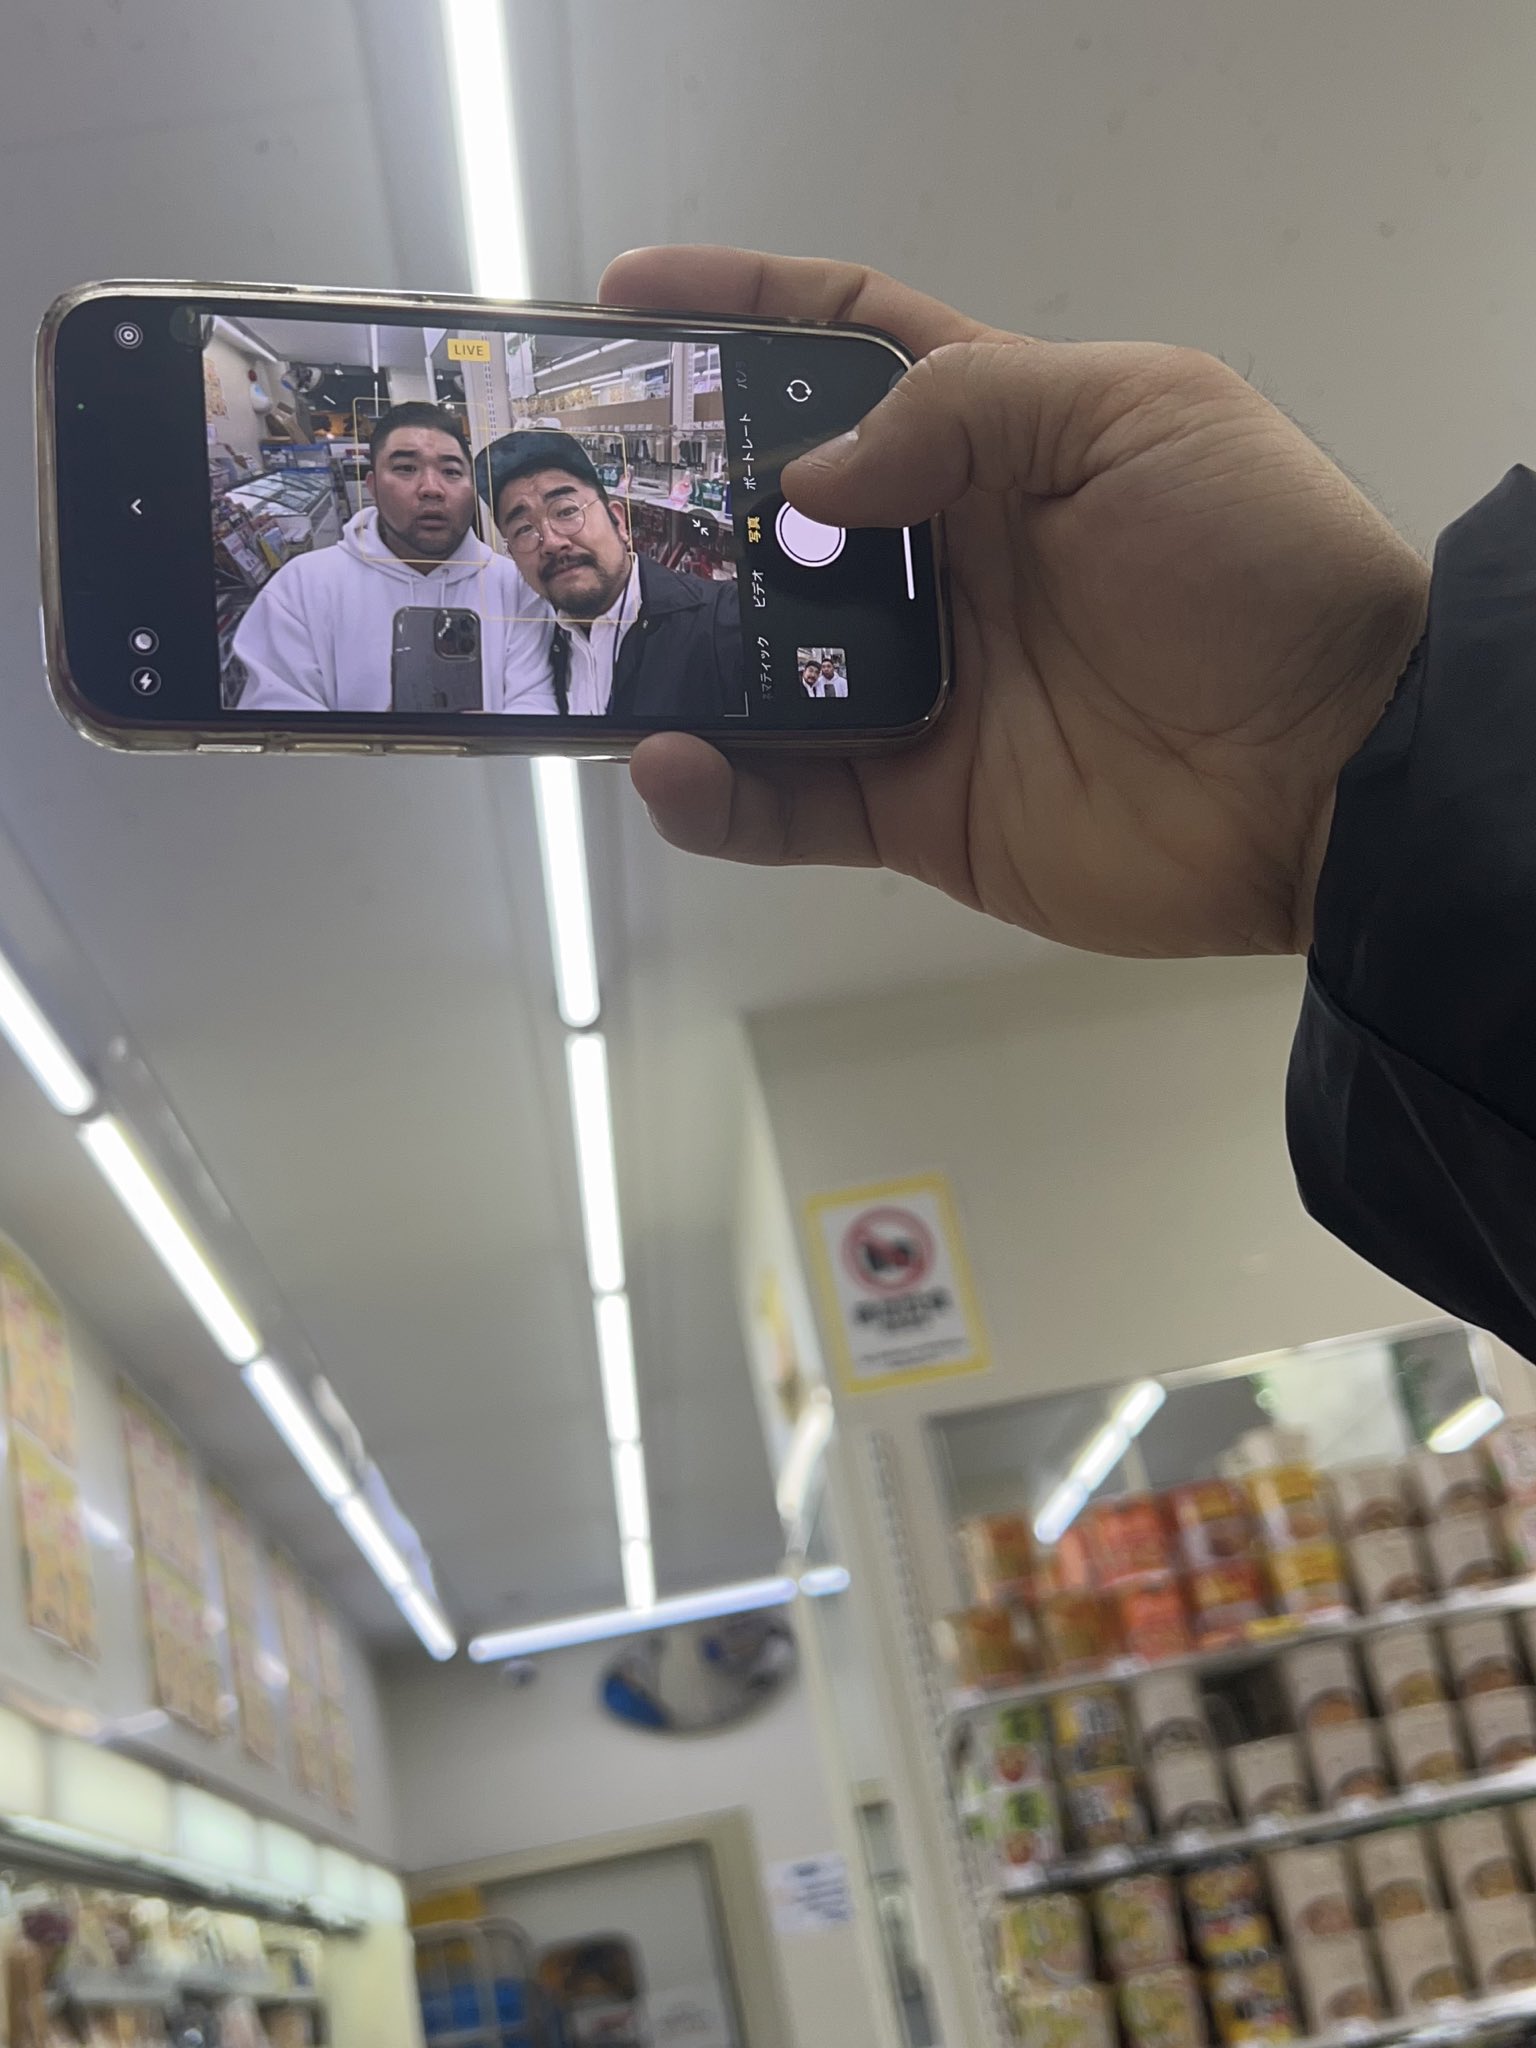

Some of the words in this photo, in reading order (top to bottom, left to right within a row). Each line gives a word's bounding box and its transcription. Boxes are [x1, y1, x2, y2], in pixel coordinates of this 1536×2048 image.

[454, 344, 484, 356] LIVE
[739, 413, 757, 491] ポートレート
[747, 516, 761, 543] 写真
[752, 569, 765, 607] ビデオ
